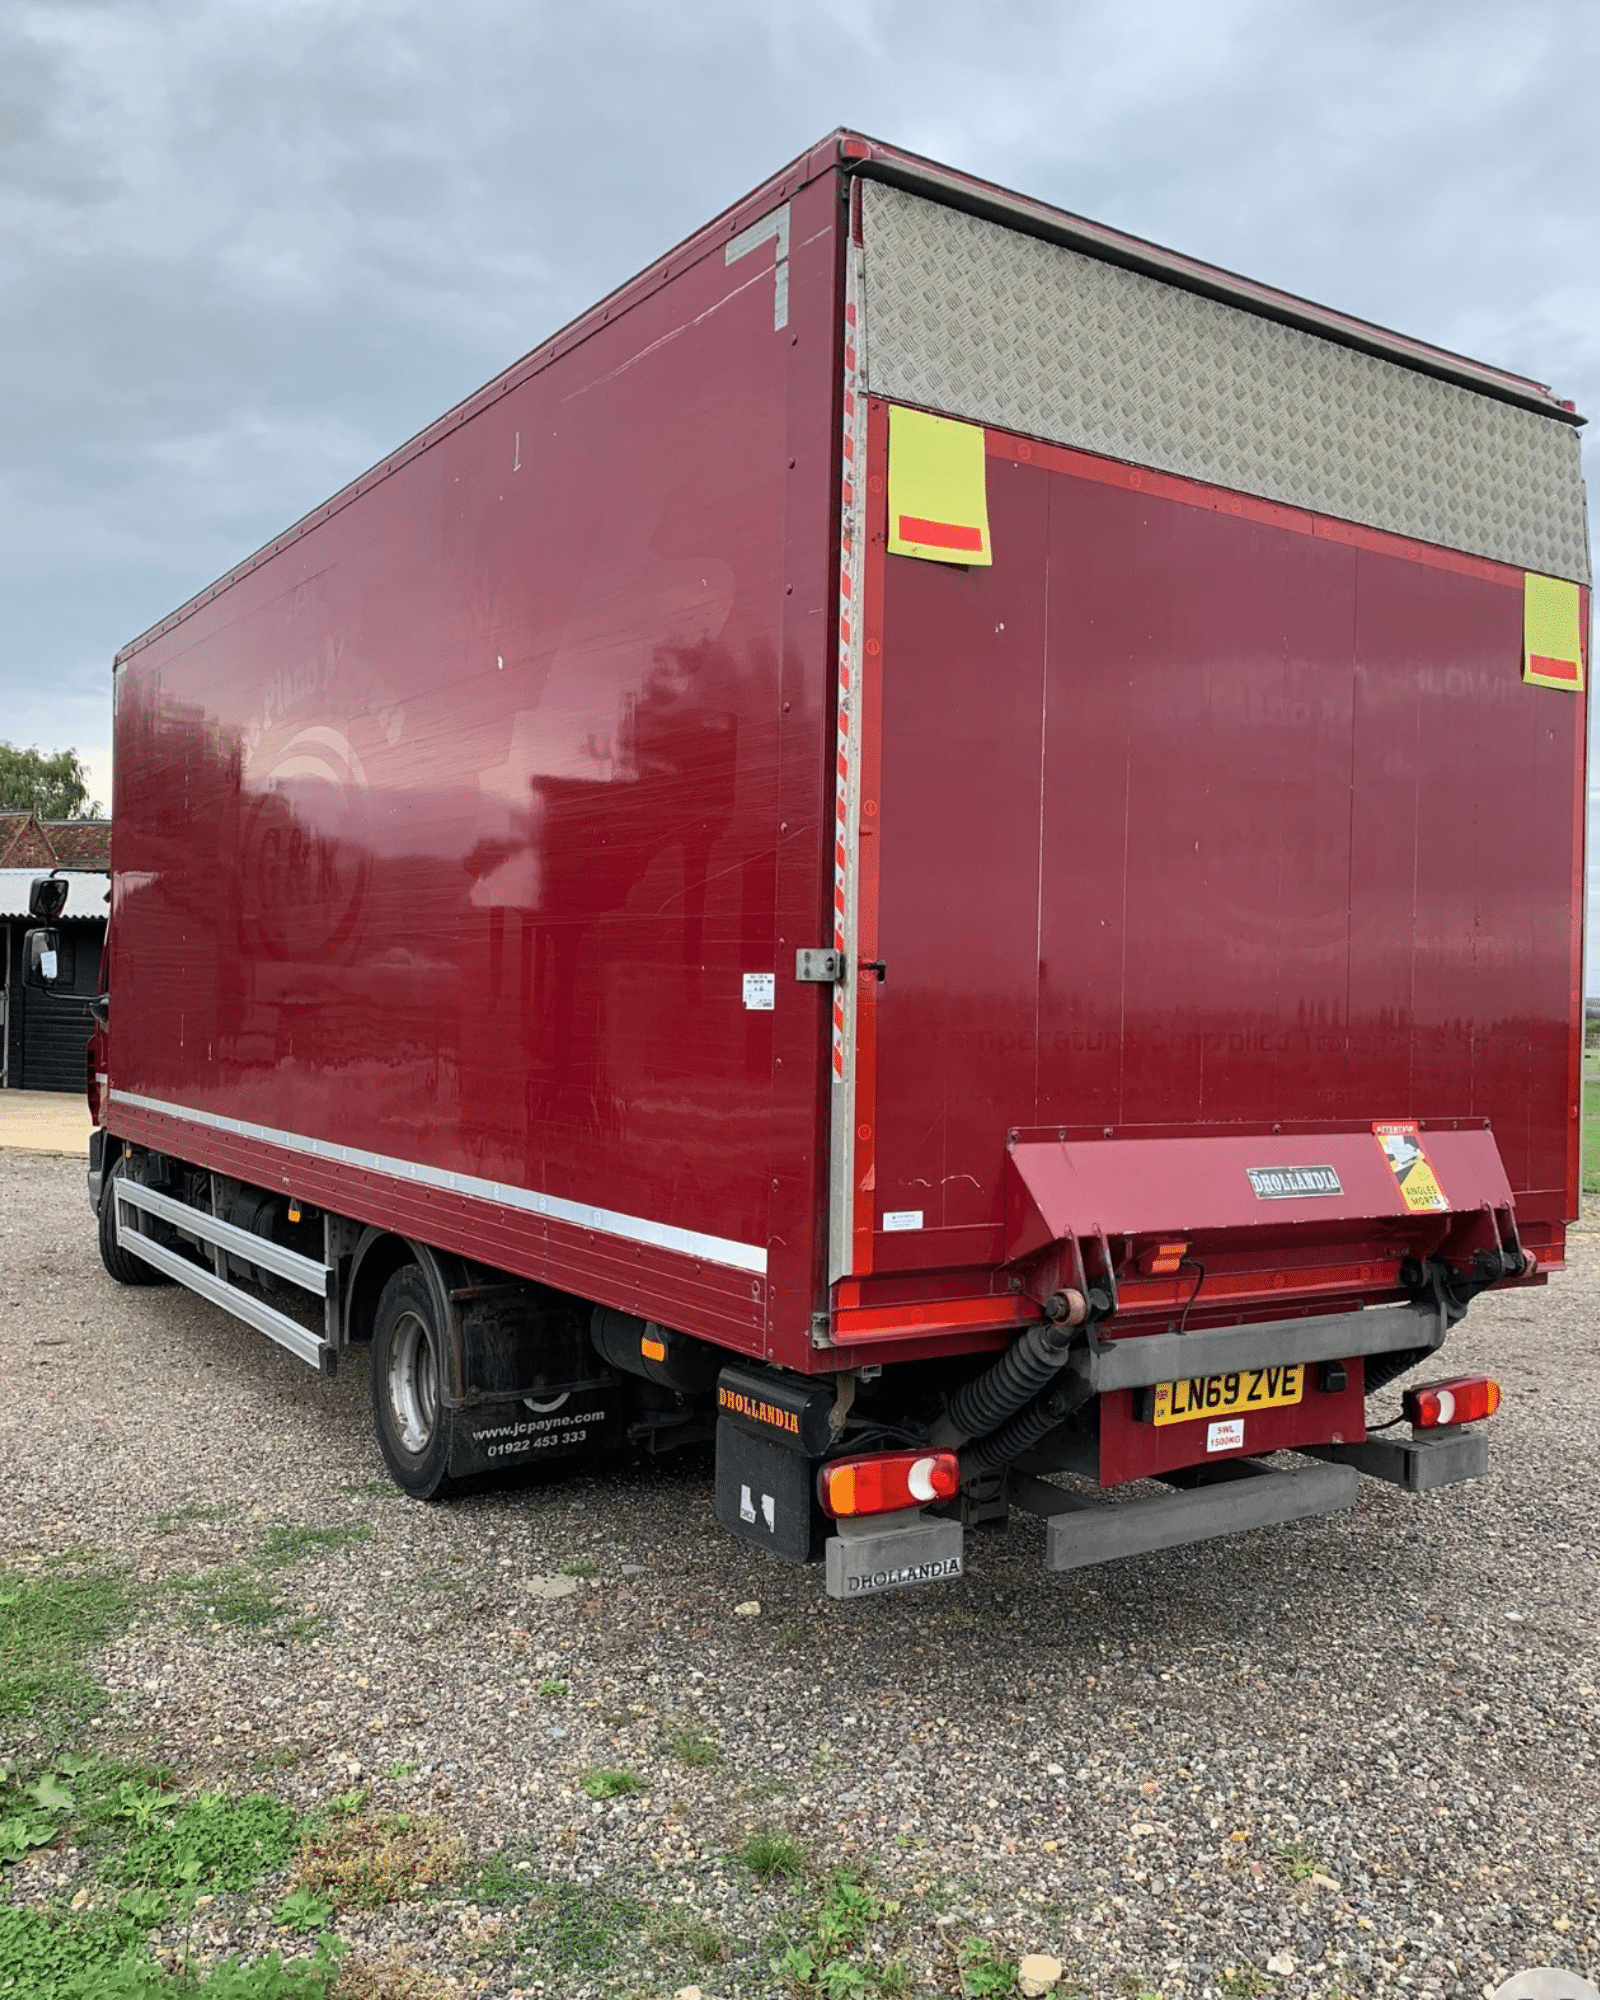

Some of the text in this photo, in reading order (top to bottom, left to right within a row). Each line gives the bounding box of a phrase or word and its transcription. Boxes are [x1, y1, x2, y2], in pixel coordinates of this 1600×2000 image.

[1250, 1171, 1341, 1193] DHOLLANDIA
[1406, 1185, 1437, 1196] ANGLES
[1411, 1195, 1441, 1205] MORTS
[1171, 1364, 1298, 1416] LN69 ZVE
[719, 1387, 799, 1434] DHOLLANDIA
[473, 1411, 605, 1441] www.jcpayne.com
[1217, 1425, 1235, 1434] SWL
[487, 1430, 587, 1457] 01922 453 333
[1210, 1434, 1241, 1446] 1500KG
[848, 1558, 960, 1591] DHOLLANDIA
